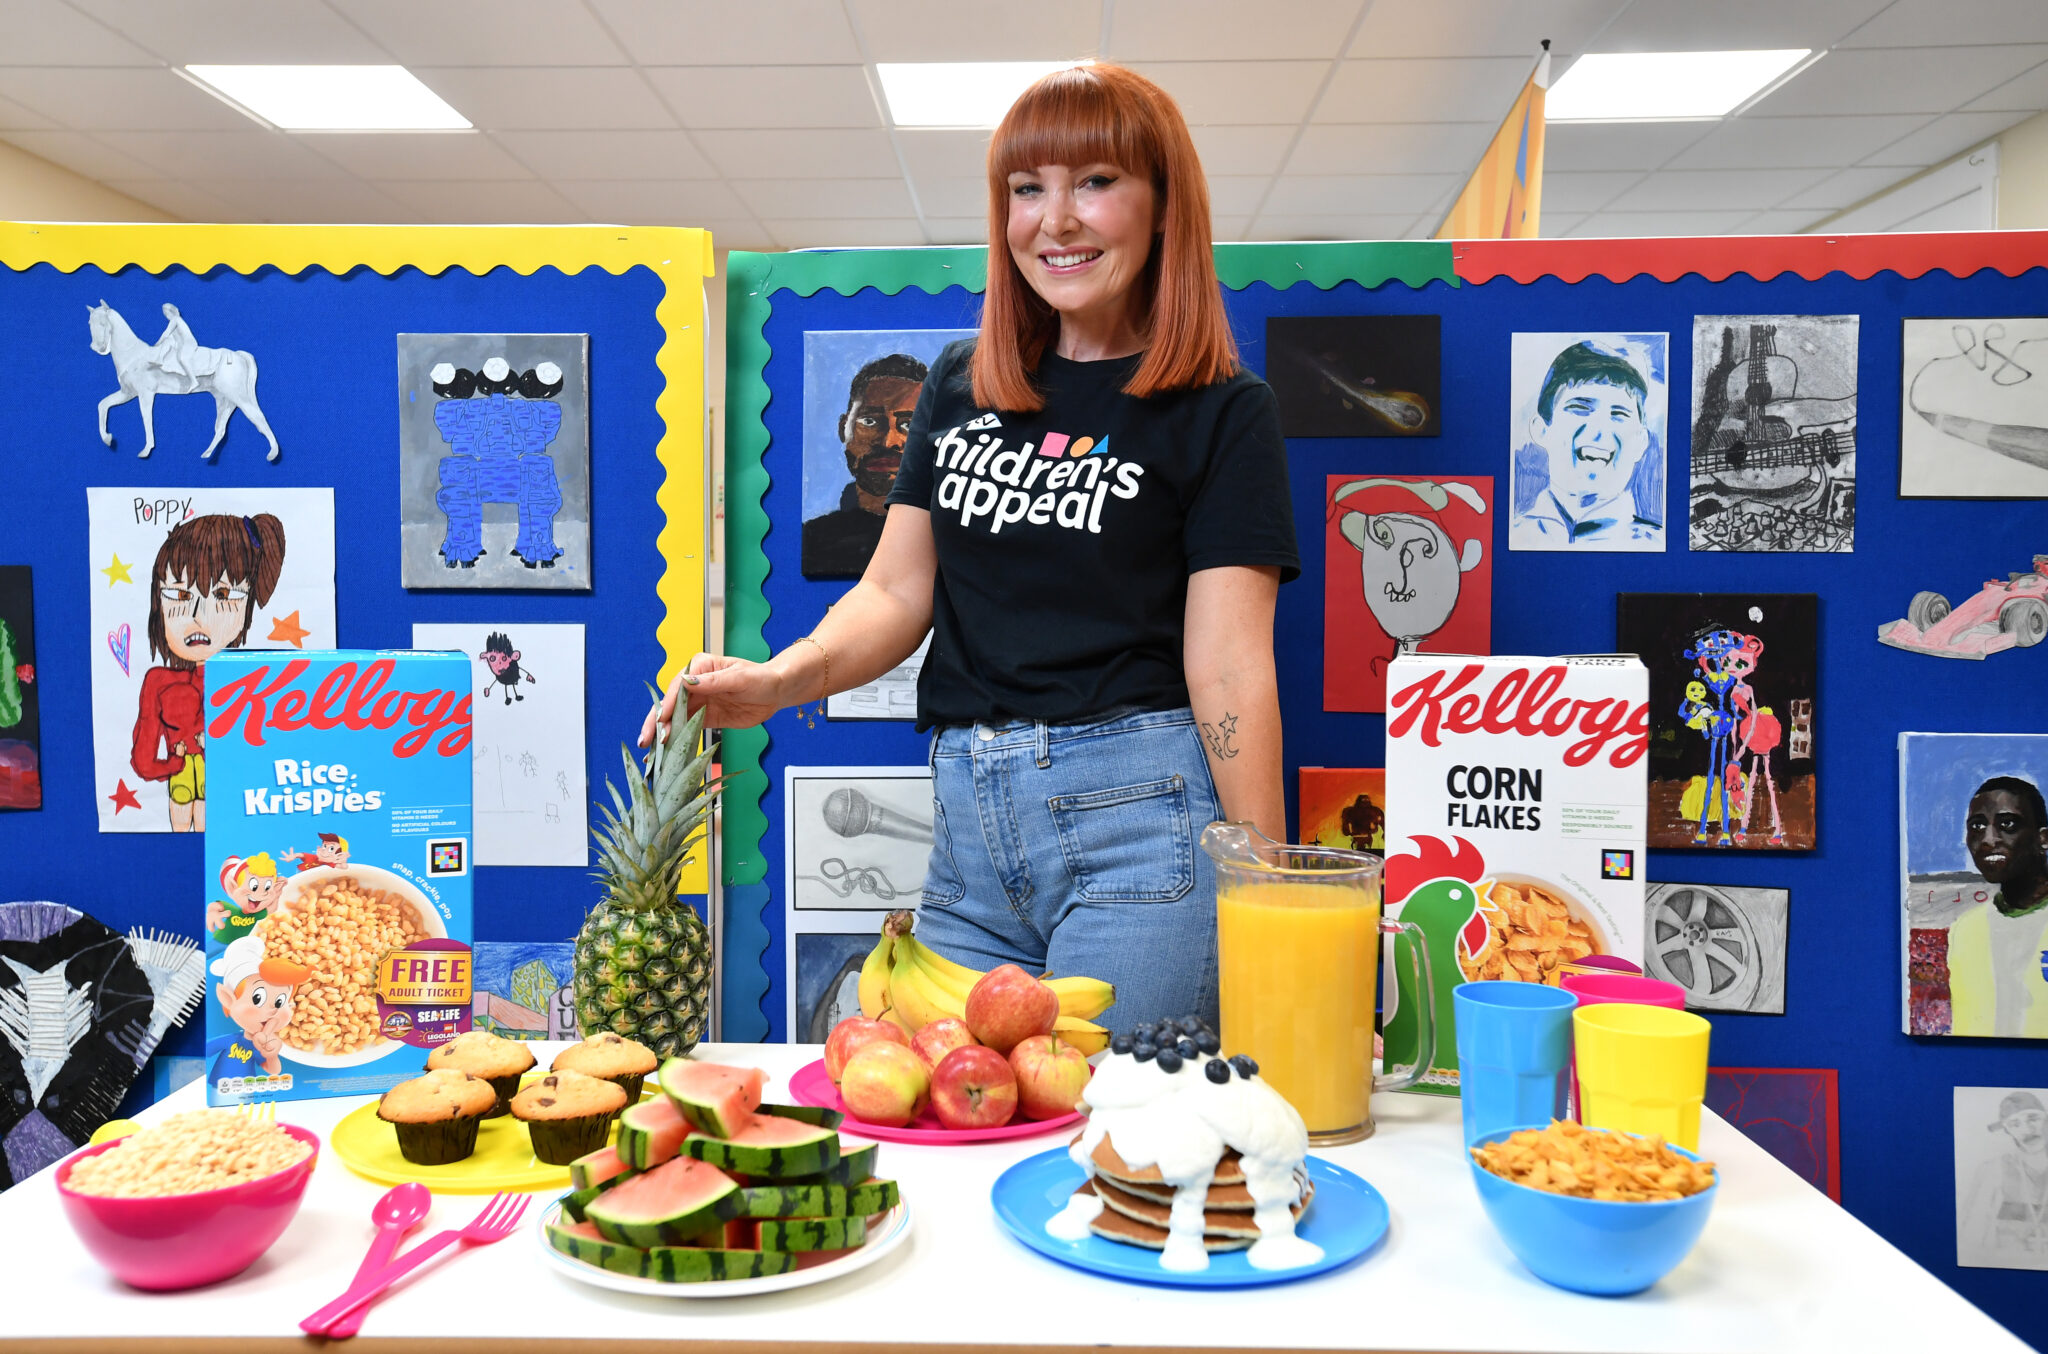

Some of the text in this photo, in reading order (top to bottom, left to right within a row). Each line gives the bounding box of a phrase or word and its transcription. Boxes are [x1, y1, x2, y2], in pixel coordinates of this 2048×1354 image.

[935, 427, 1145, 500] hildren's
[938, 472, 1109, 534] appeal
[274, 759, 349, 787] Rice
[1447, 765, 1542, 802] CORN
[244, 785, 382, 815] Krispies
[1447, 803, 1541, 831] FLAKES
[392, 862, 413, 879] snap,
[438, 903, 452, 919] pop
[390, 958, 466, 983] FREE
[389, 987, 464, 997] ADULT TICKET
